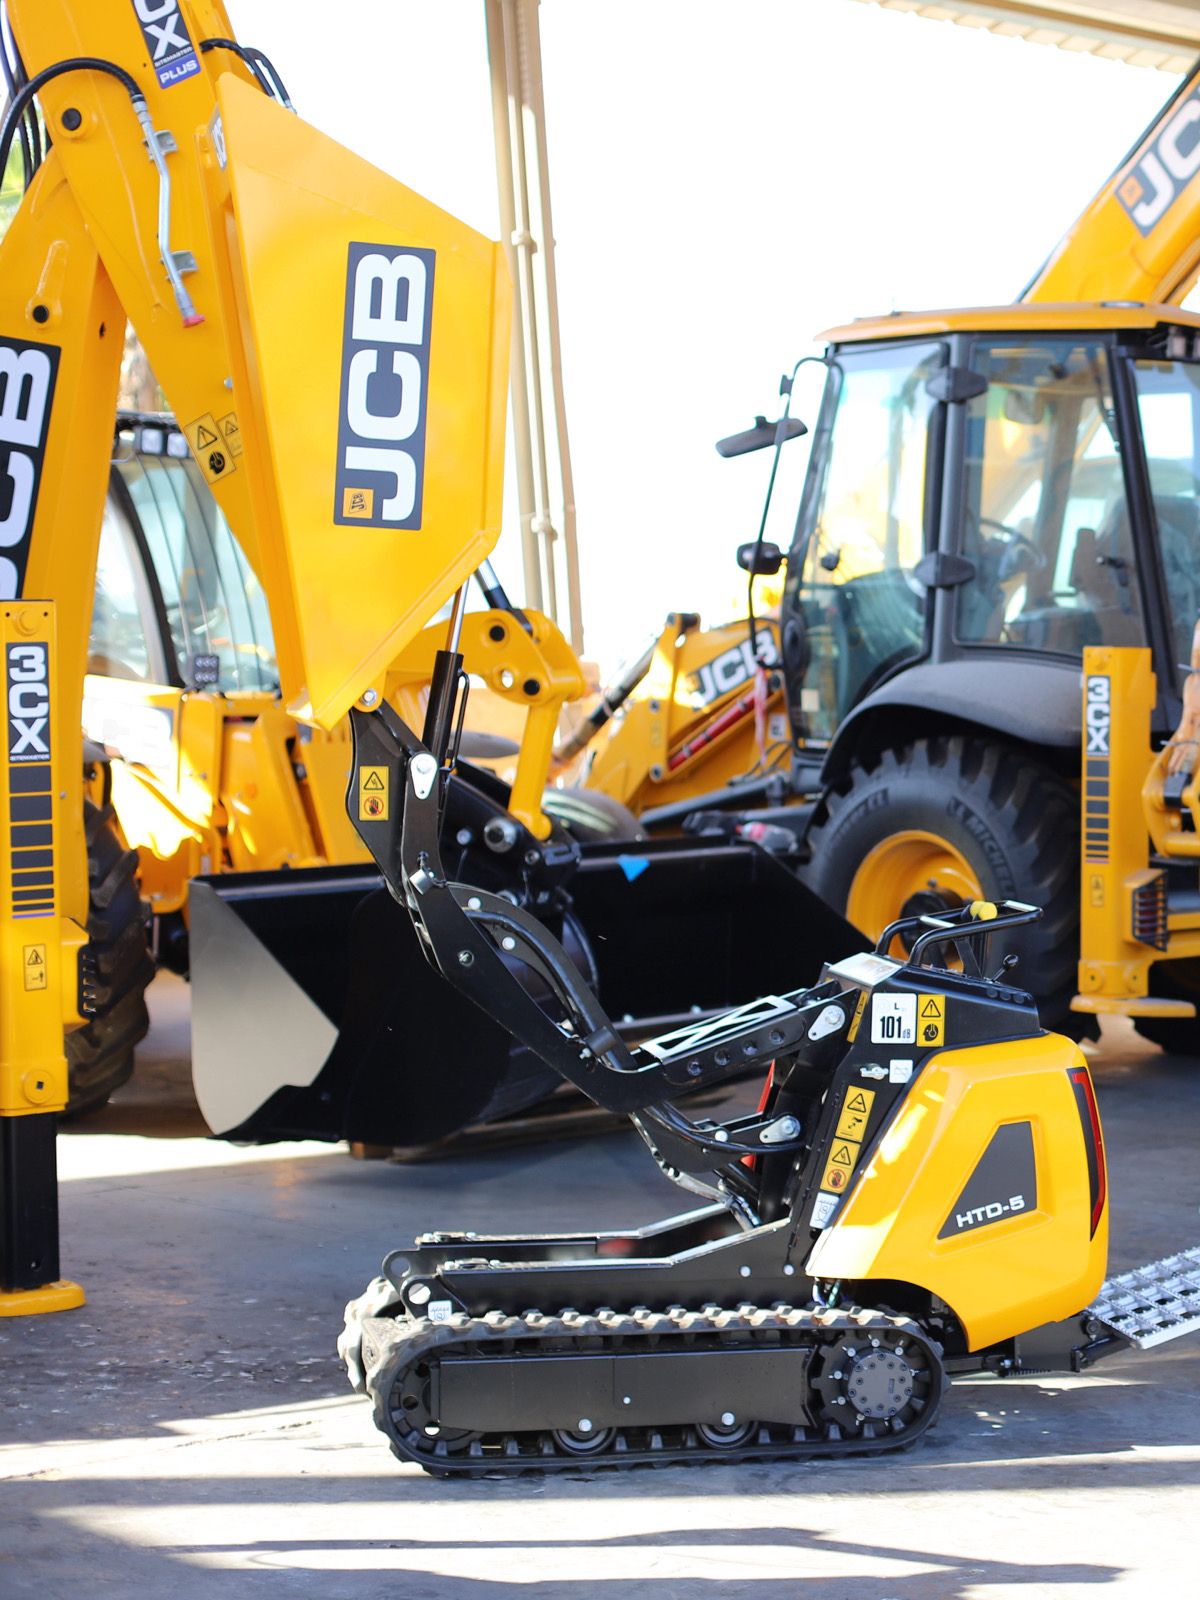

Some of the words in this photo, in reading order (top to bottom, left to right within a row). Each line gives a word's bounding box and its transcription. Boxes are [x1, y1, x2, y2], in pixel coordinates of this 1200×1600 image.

[159, 60, 198, 84] PLUS
[345, 253, 427, 522] JCB
[9, 645, 50, 754] 3CX
[692, 629, 778, 709] JCB
[1087, 676, 1110, 752] 3CX
[880, 1016, 903, 1039] 101
[955, 1194, 1026, 1228] HTD-5
